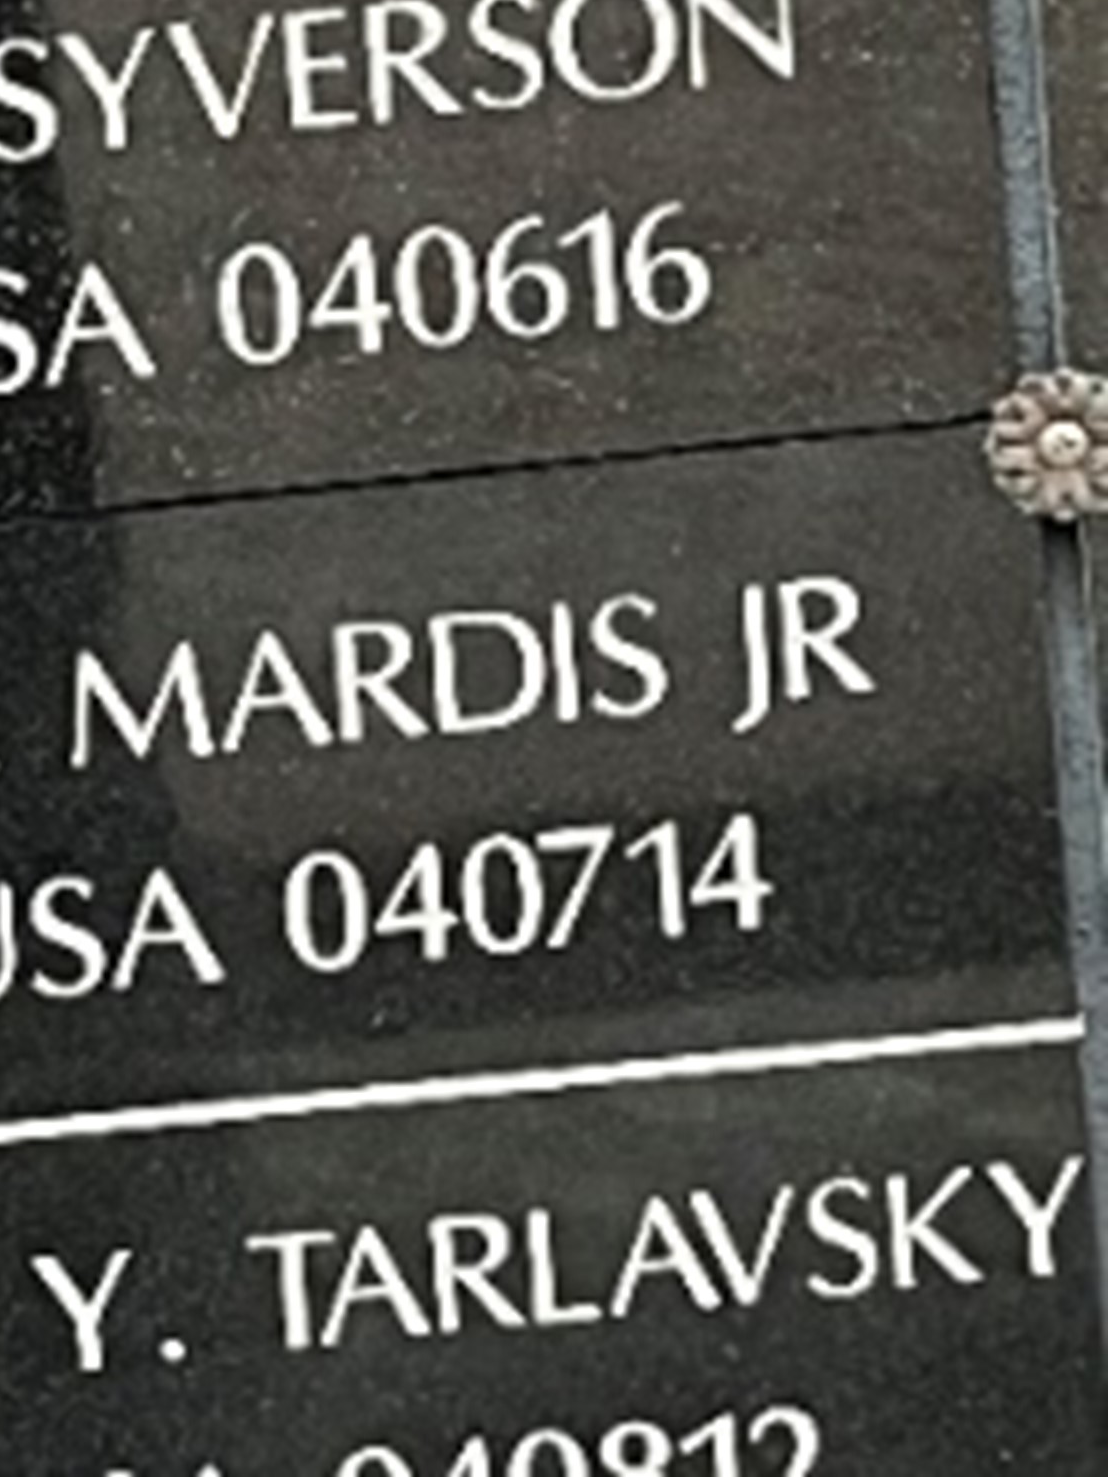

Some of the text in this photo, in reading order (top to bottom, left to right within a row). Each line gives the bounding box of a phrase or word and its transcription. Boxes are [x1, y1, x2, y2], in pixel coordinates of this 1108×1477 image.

[217, 201, 712, 366] 040616
[70, 597, 669, 768] MARDIS
[732, 576, 875, 734] JR
[284, 813, 773, 973] 040714
[31, 1249, 187, 1372] Y.
[245, 1156, 1082, 1350] TARLAVSKY
[337, 1406, 819, 1477] 812
